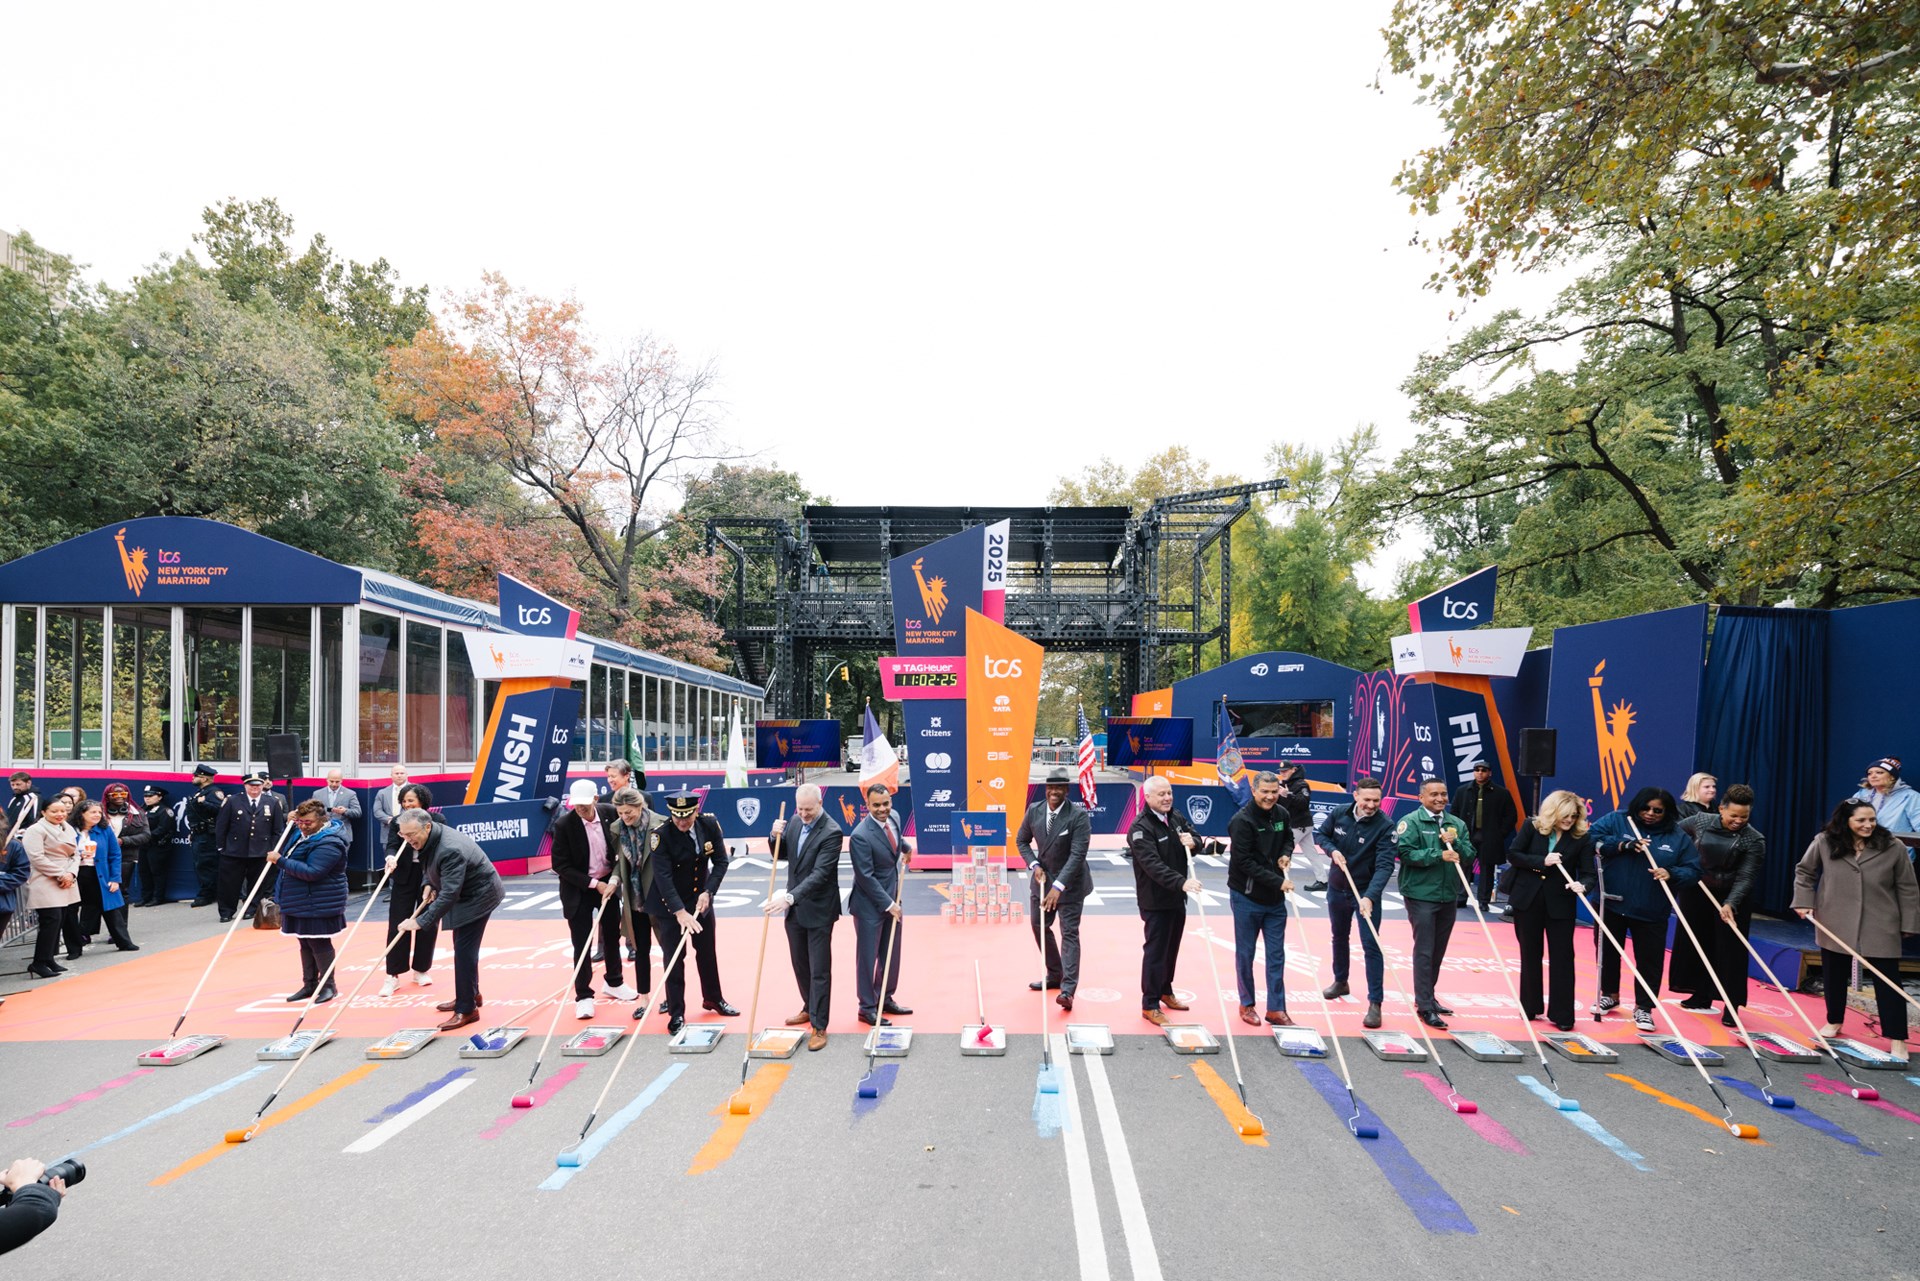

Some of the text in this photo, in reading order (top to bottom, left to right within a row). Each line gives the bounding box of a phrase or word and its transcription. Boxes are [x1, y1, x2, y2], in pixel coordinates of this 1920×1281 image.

[158, 548, 181, 564] tcs
[987, 534, 1004, 583] 2025
[157, 567, 229, 576] NEW YORK CITY
[157, 576, 211, 585] MARATHON
[518, 604, 552, 626] tcs
[1442, 596, 1479, 620] tcs
[905, 618, 922, 629] tcs
[985, 655, 1022, 679] tcs
[1278, 664, 1304, 673] ESPN
[552, 725, 568, 744] tcs
[1413, 722, 1432, 742] tcs
[1448, 712, 1485, 783] FINI
[493, 713, 538, 803] NISH
[545, 774, 560, 783] TATA
[456, 819, 520, 834] CENTRAL PARK
[465, 828, 520, 843] NSERVANCY
